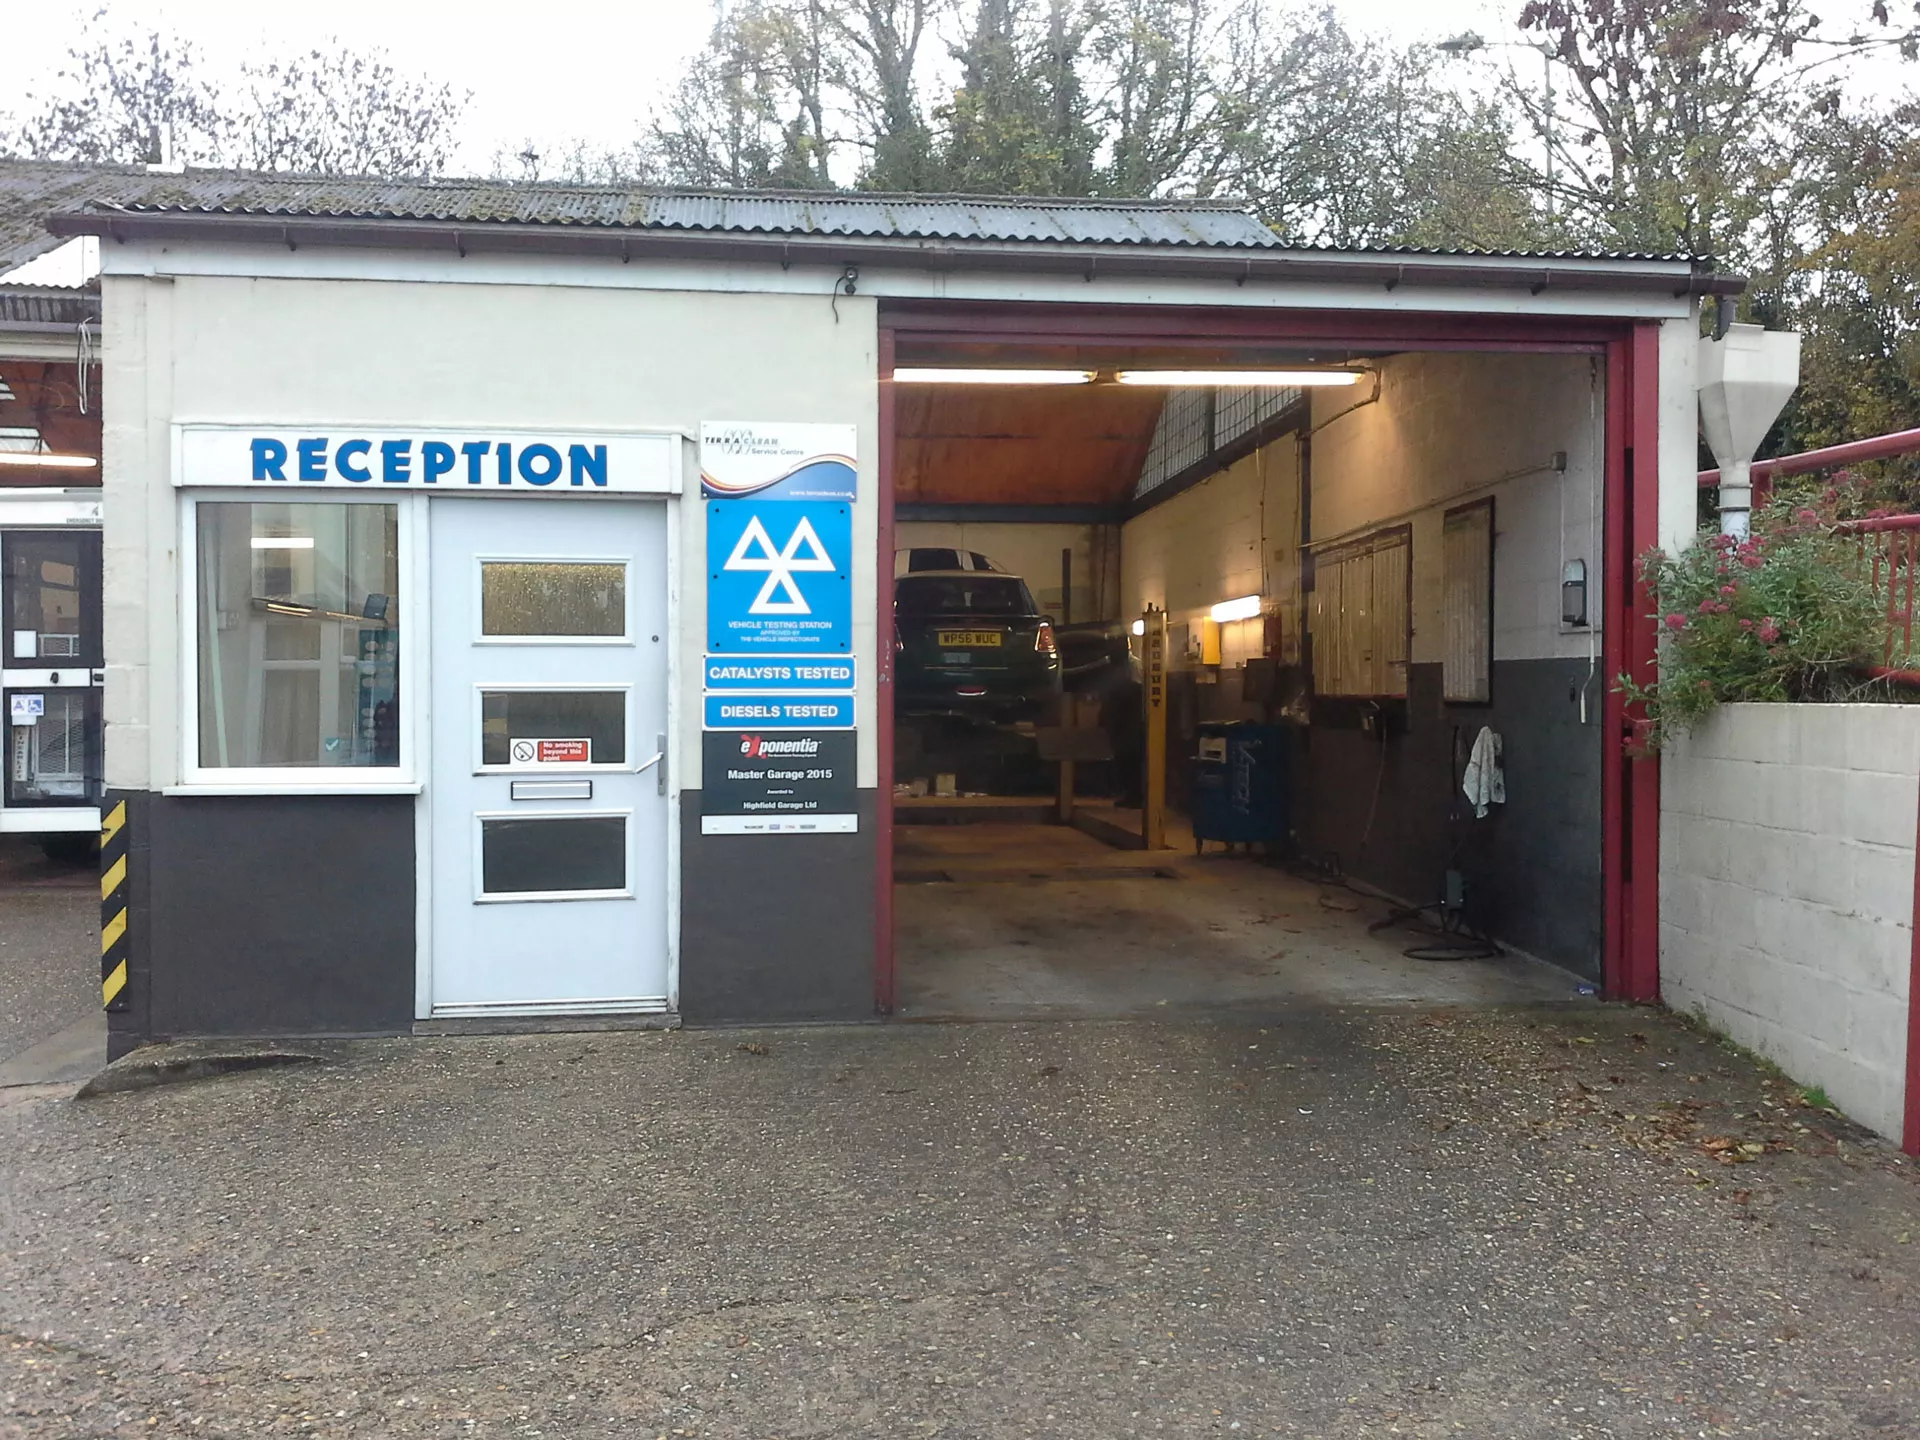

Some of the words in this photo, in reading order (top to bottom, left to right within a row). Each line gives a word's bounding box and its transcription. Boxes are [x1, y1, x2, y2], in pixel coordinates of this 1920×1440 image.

[780, 448, 804, 456] Centre
[249, 437, 608, 487] RECEPTION
[728, 621, 762, 629] VEHICLE
[764, 621, 798, 629] TESTING
[799, 621, 832, 629] STATION
[709, 666, 791, 679] CATALYSTS
[794, 667, 850, 679] TESTED
[720, 705, 780, 718] DIESELS
[784, 705, 839, 717] TESTED
[555, 741, 583, 749] smoking
[740, 734, 819, 759] exponentia
[543, 748, 568, 756] beyond
[728, 770, 765, 779] Master
[767, 769, 804, 780] Garage
[806, 769, 833, 779] 2015
[743, 801, 776, 810] Highfield
[778, 801, 804, 810] Garage
[805, 801, 818, 809] Ltd
